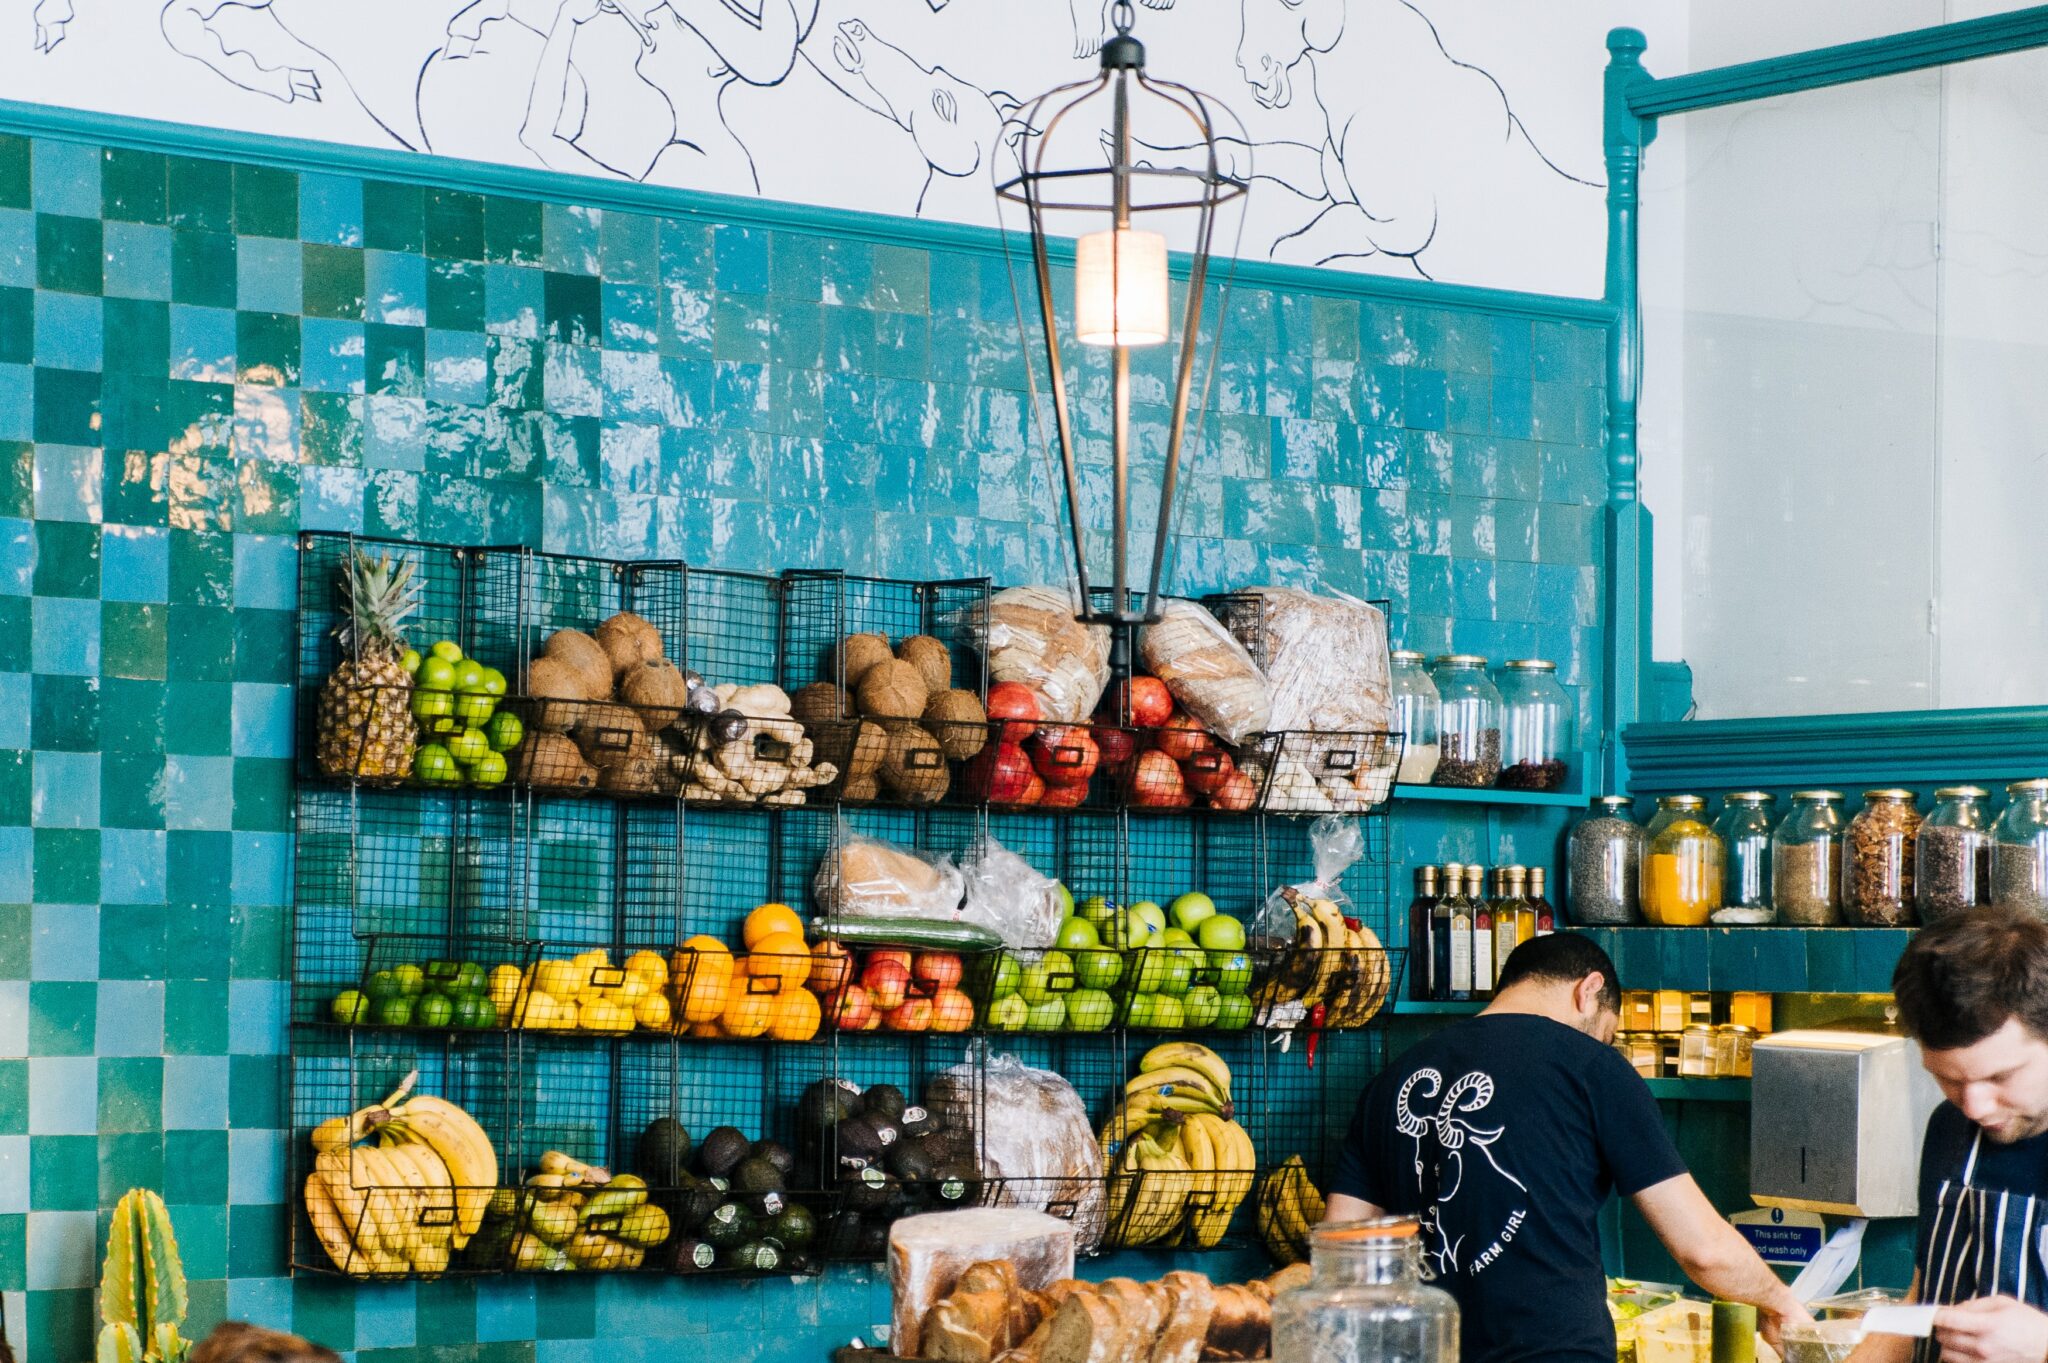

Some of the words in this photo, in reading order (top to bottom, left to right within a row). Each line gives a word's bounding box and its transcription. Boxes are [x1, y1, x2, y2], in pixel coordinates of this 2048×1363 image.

[1755, 1230, 1771, 1239] This
[1773, 1231, 1788, 1239] sink
[1790, 1231, 1802, 1240] for
[1470, 1242, 1503, 1276] FARM
[1501, 1210, 1526, 1242] GIRL
[1768, 1245, 1788, 1254] wash
[1790, 1247, 1807, 1258] only
